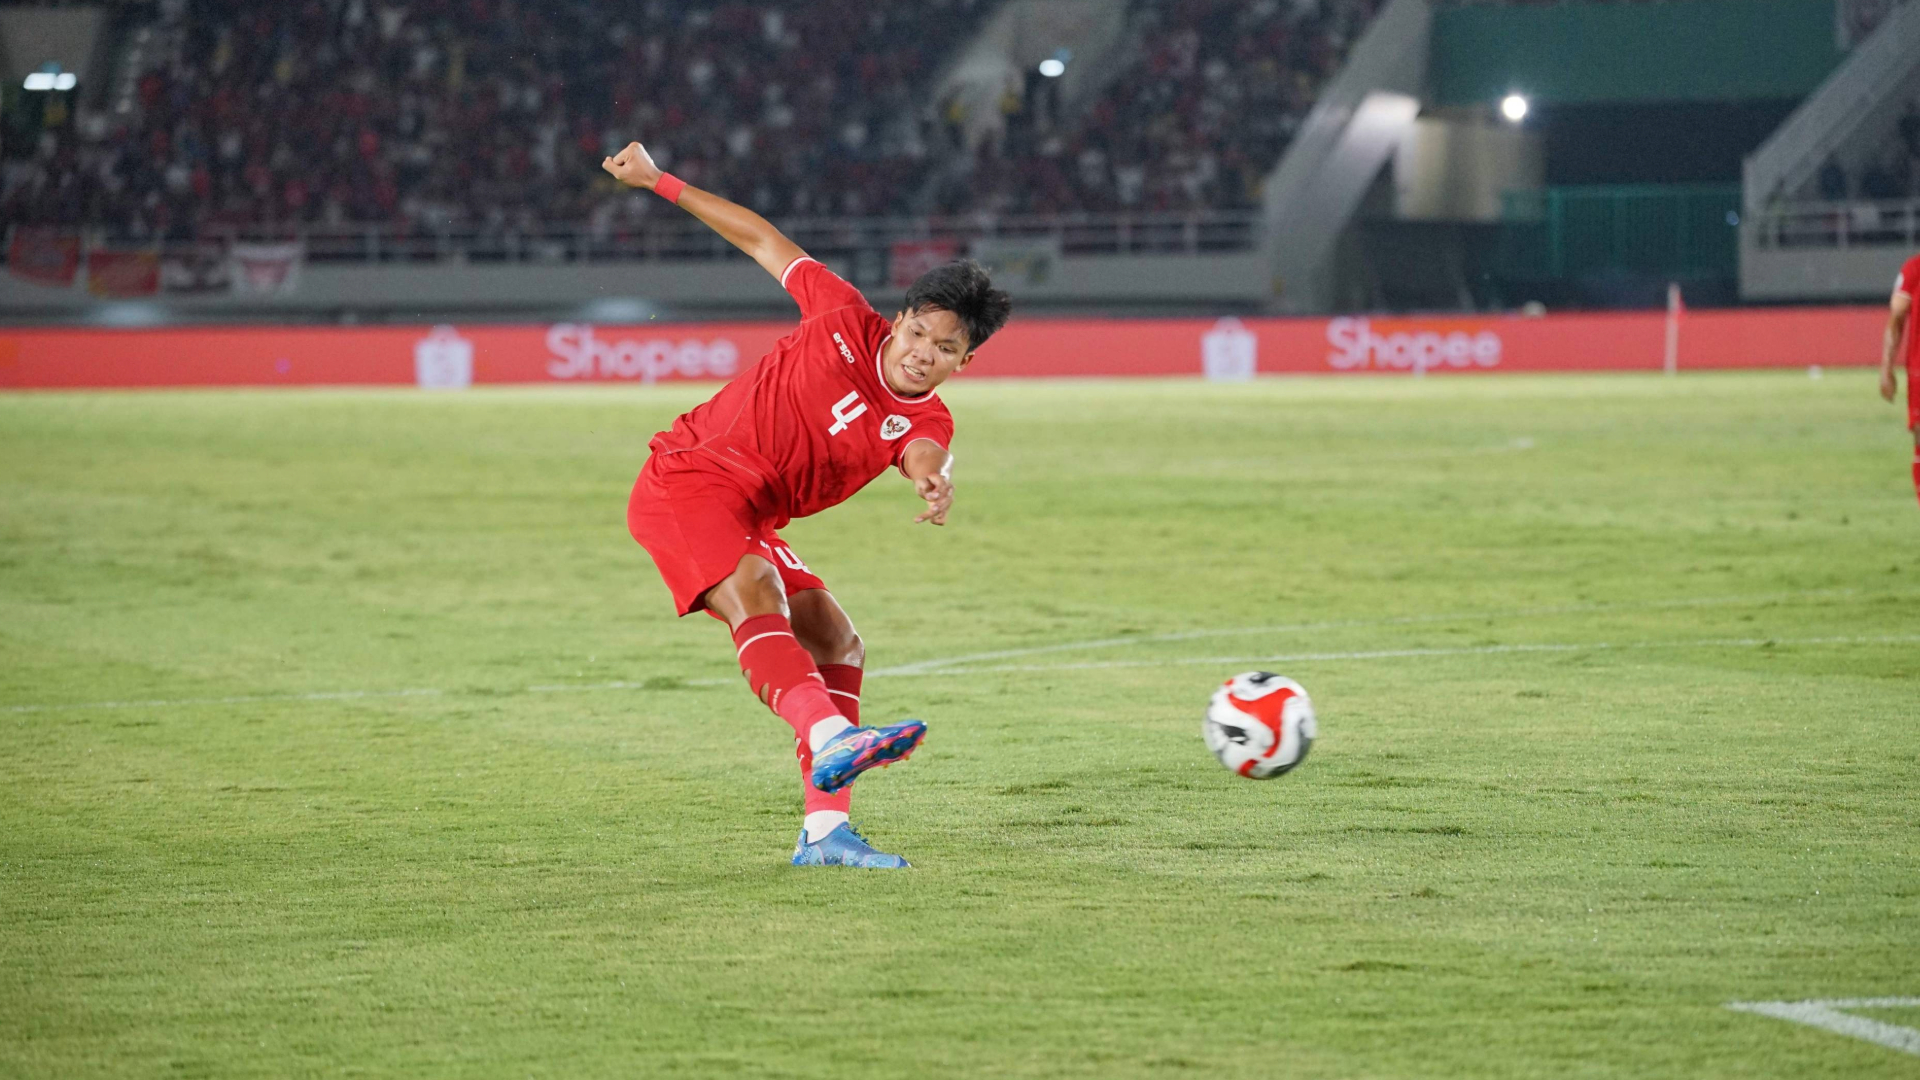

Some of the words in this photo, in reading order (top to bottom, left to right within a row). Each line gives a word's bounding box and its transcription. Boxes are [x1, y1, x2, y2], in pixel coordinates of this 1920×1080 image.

[546, 323, 739, 386] Shopee
[832, 332, 855, 364] erspo
[1326, 316, 1502, 377] Shopee
[828, 390, 868, 436] 4
